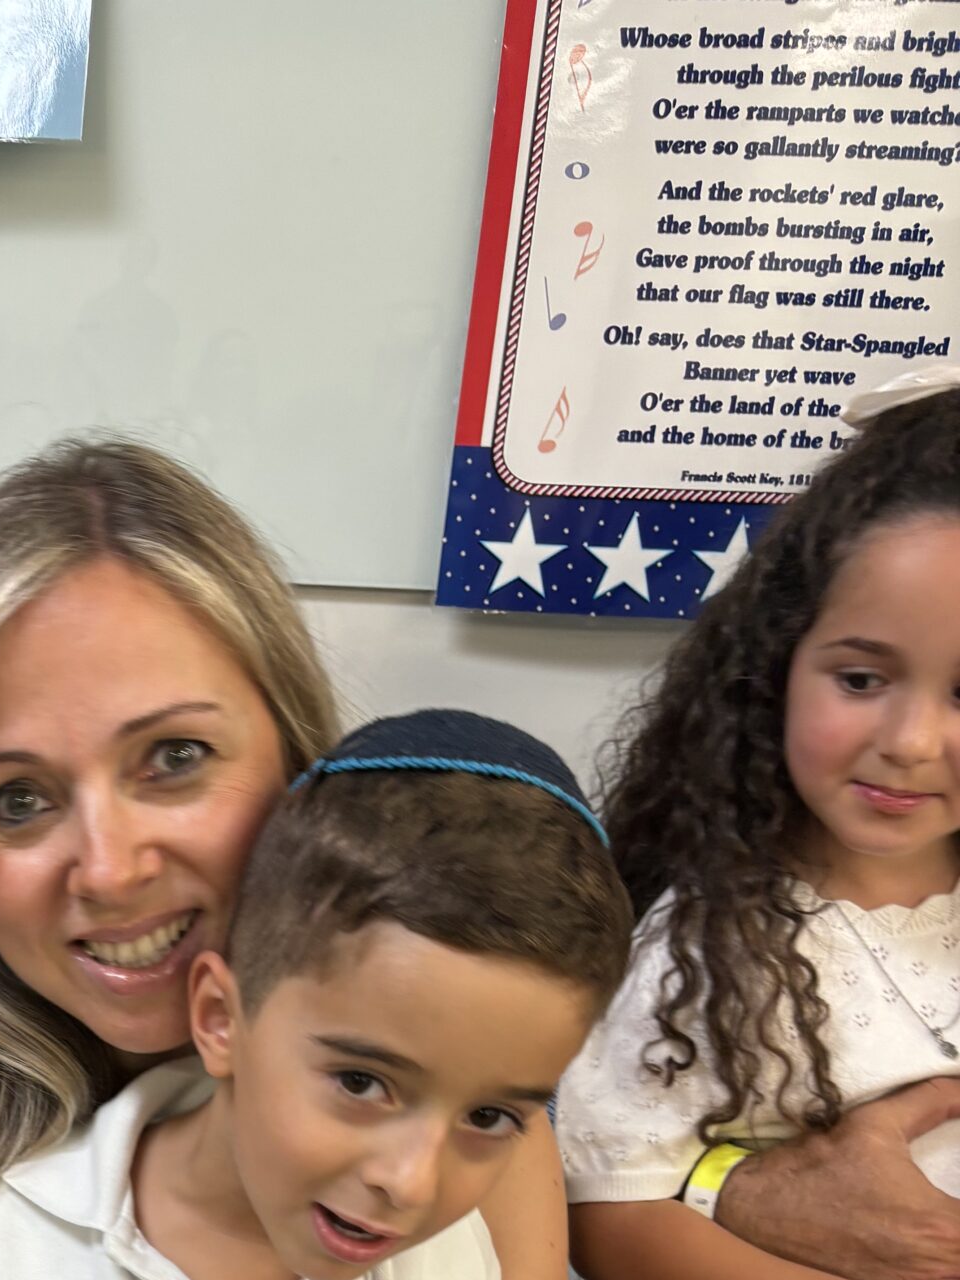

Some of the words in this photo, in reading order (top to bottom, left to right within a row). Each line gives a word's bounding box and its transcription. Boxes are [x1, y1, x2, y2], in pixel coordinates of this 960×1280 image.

[621, 27, 692, 48] Whose
[699, 27, 765, 48] broad
[770, 29, 847, 53] stripes
[854, 30, 896, 51] and
[903, 30, 960, 56] brigh
[678, 63, 763, 87] through
[771, 64, 806, 85] the
[812, 66, 903, 90] perilous
[653, 99, 699, 119] O'er
[705, 99, 739, 120] the
[746, 104, 846, 125] ramparts
[854, 109, 883, 123] we
[655, 140, 706, 154] were
[713, 141, 738, 155] so
[744, 136, 839, 162] gallantly
[658, 180, 702, 200] And
[709, 182, 743, 201] the
[749, 183, 834, 204] rockets'
[840, 186, 877, 205] red
[882, 187, 943, 211] glare,
[658, 216, 691, 234] the
[698, 216, 769, 236] bombs
[776, 218, 866, 244] bursting
[871, 221, 892, 241] in
[899, 223, 933, 245] air,
[636, 248, 688, 268] Gave
[693, 251, 755, 273] proof
[759, 252, 842, 277] through
[850, 255, 883, 275] the
[889, 257, 945, 280] night
[637, 283, 679, 301] that
[686, 289, 723, 302] our
[729, 284, 769, 309] flag
[776, 292, 816, 306] was
[822, 289, 864, 308] still
[870, 290, 930, 311] there.
[604, 326, 642, 345] Oh!
[648, 333, 688, 350] say,
[696, 329, 745, 348] does
[753, 330, 795, 350] that
[801, 332, 950, 358] Star-Spangled
[684, 361, 760, 381] Banner
[765, 367, 797, 386] yet
[804, 371, 855, 385] wave
[641, 393, 684, 412] O'er
[690, 394, 723, 413] the
[729, 395, 775, 415] land
[780, 397, 804, 416] of
[808, 398, 841, 417] the
[617, 425, 656, 443] and
[663, 426, 694, 444] the
[701, 427, 757, 447] home
[763, 429, 787, 447] of
[791, 430, 823, 449] the
[681, 471, 723, 482] Francis
[726, 472, 756, 483] Scott
[789, 474, 813, 486] 181
